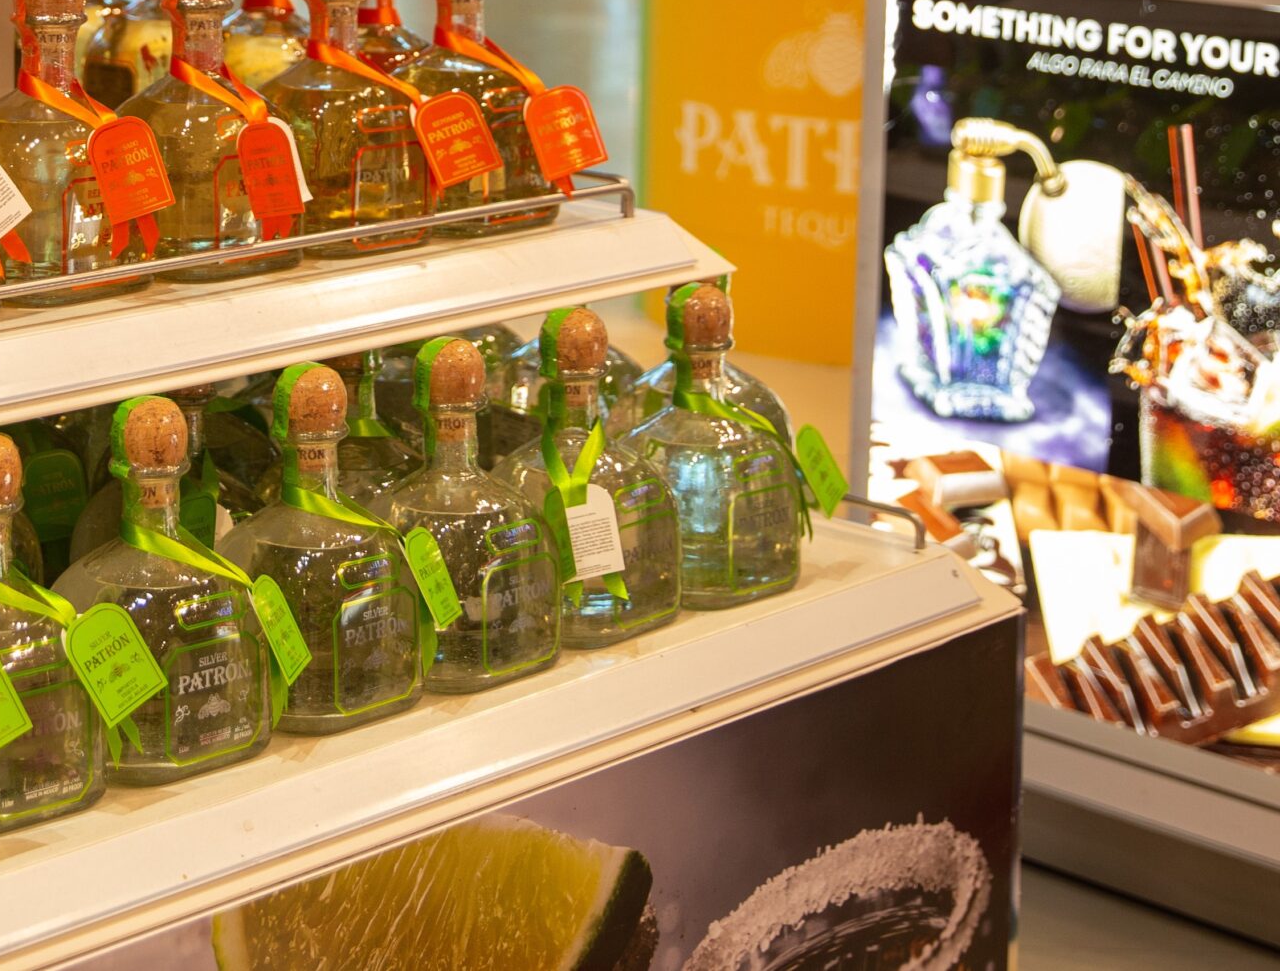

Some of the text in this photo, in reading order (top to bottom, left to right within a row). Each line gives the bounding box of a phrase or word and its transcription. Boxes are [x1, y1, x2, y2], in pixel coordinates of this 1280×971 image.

[1107, 23, 1177, 63] FOR
[1180, 31, 1280, 78] YOUR
[1026, 51, 1235, 99] ALGO PARA EL CAMINO
[198, 651, 228, 668] SILVER
